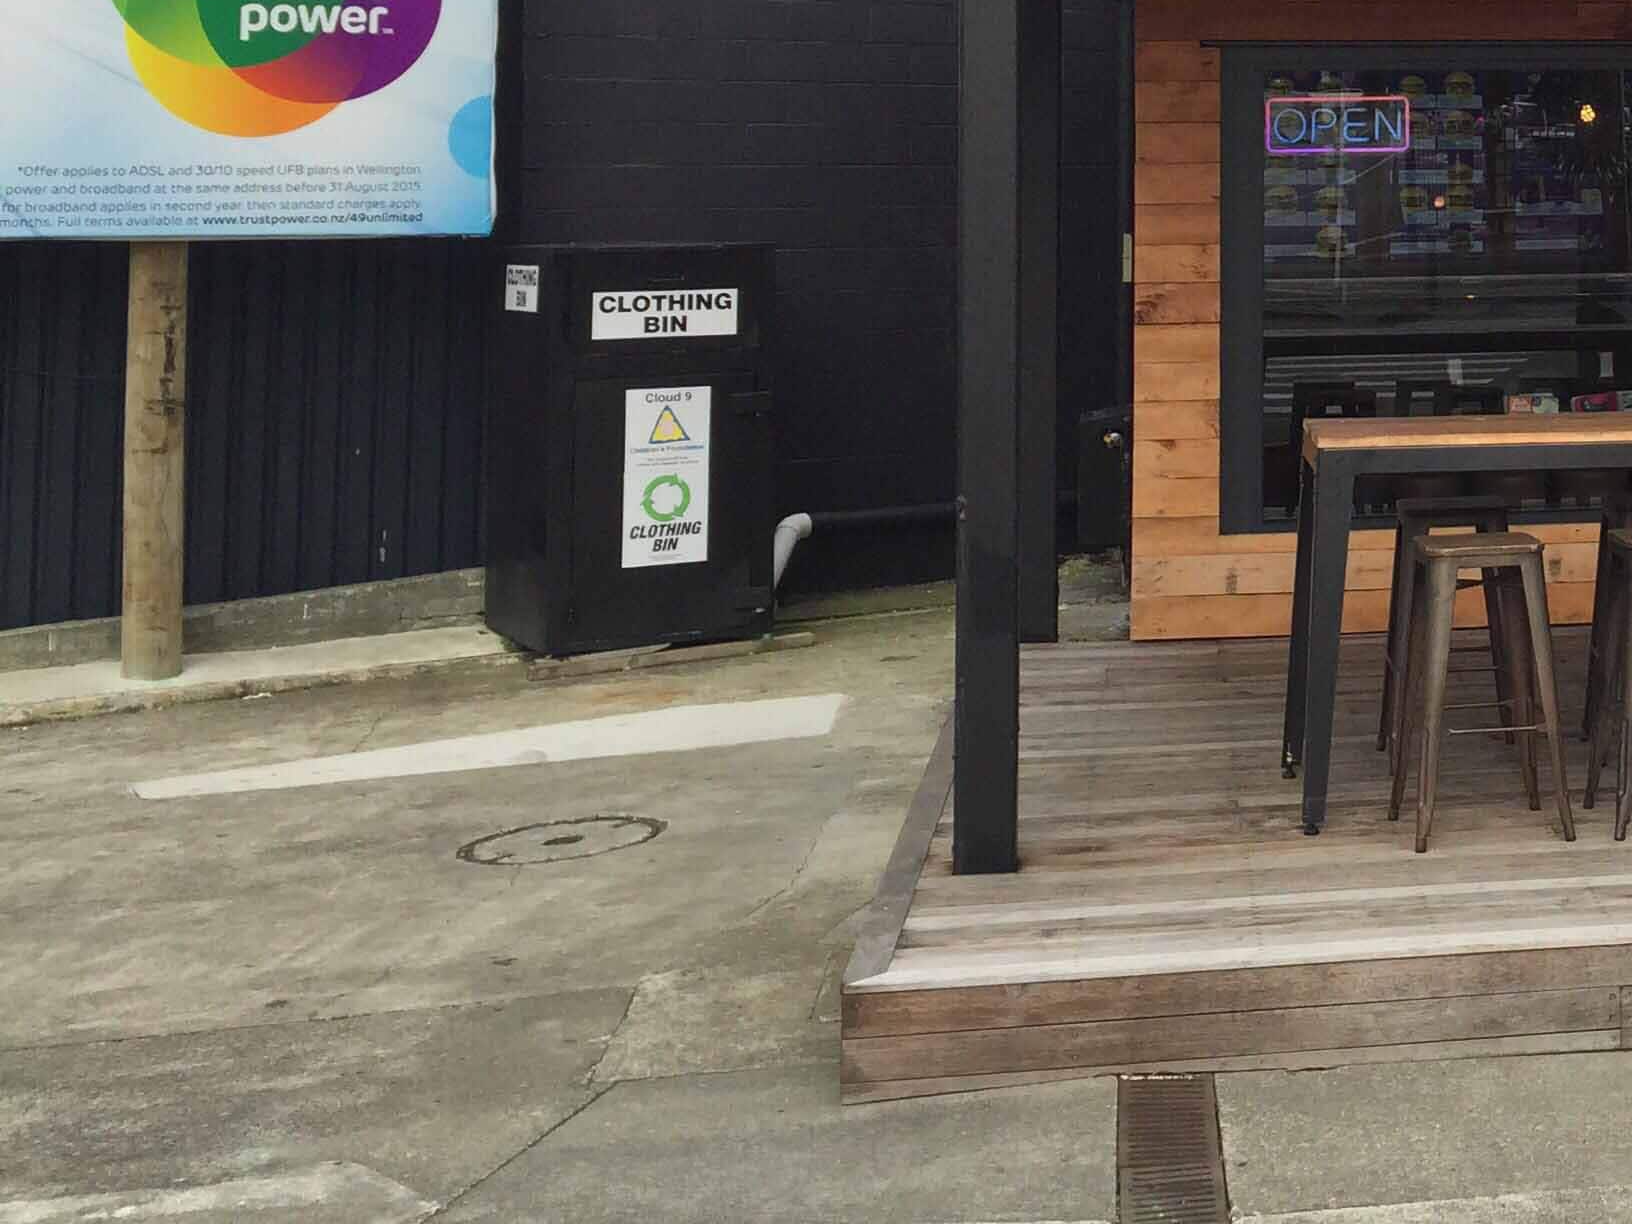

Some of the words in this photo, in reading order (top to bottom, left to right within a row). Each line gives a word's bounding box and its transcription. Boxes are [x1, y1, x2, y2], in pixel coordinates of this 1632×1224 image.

[240, 3, 388, 41] power
[1272, 107, 1404, 145] OPEN
[62, 166, 108, 177] applies
[112, 167, 125, 176] to
[129, 166, 164, 176] ADSL
[168, 165, 193, 176] and
[236, 164, 274, 177] speed
[277, 164, 304, 176] UFB
[307, 164, 339, 177] plans
[343, 164, 355, 175] in
[356, 164, 421, 176] Wellington
[6, 185, 47, 195] power
[51, 183, 76, 194] and
[80, 182, 150, 194] broadband
[154, 184, 167, 193] at
[171, 182, 192, 193] the
[196, 184, 229, 193] same
[233, 182, 282, 192] address
[286, 181, 328, 192] before
[345, 181, 389, 193] August
[25, 201, 96, 212] broadband
[100, 201, 147, 214] applies
[151, 201, 161, 211] in
[165, 200, 211, 211] second
[247, 199, 276, 210] then
[279, 199, 334, 210] standard
[338, 198, 385, 211] charges
[57, 216, 81, 227] Full
[85, 218, 122, 227] terms
[126, 215, 183, 226] available
[186, 216, 199, 226] at
[599, 292, 733, 314] CLOTHING
[643, 315, 688, 334] BIN
[645, 391, 681, 403] Cloud
[684, 391, 692, 402] 9
[629, 520, 702, 540] CLOTHING
[652, 537, 679, 553] BIN
